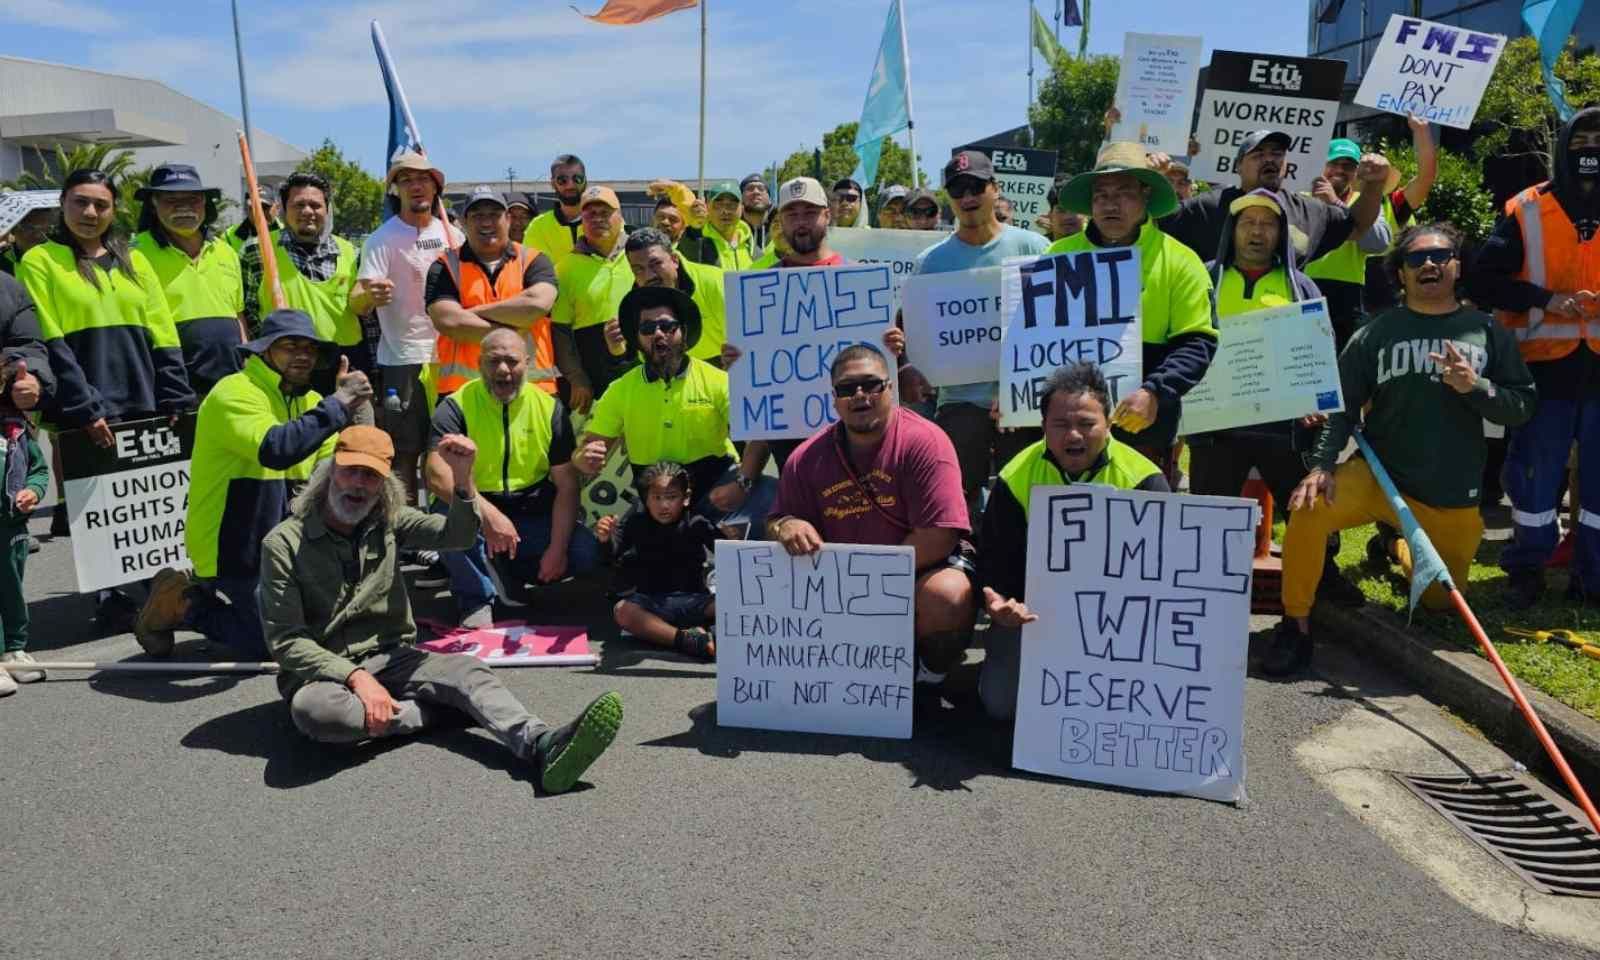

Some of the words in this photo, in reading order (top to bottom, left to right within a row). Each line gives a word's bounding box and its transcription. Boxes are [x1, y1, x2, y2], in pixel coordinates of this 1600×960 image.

[1400, 54, 1464, 83] DONT
[1399, 81, 1445, 106] PAY
[1213, 100, 1325, 127] WORKERS
[1214, 128, 1312, 154] DEVE
[999, 180, 1046, 195] RKERS
[740, 267, 890, 337] FMI
[1020, 250, 1135, 329] FMI
[936, 298, 989, 317] TOOT
[939, 326, 1002, 347] SUPPO
[750, 341, 880, 389] LOCK
[1013, 338, 1123, 373] LOCKED
[1011, 376, 1048, 413] ME
[743, 394, 788, 431] ME
[804, 394, 838, 428] OU
[86, 497, 175, 530] RIGHTS
[114, 519, 185, 549] HUMA
[1048, 493, 1252, 595] FMI
[121, 543, 185, 574] RIGH
[737, 546, 912, 616] FMI
[724, 612, 823, 639] LEADING
[1075, 591, 1206, 672] WE
[746, 643, 911, 673] MANUFACTURER
[733, 677, 776, 704] BUT
[794, 681, 832, 705] NOT
[843, 683, 911, 711] STAFF
[1040, 668, 1212, 722] DESERVE
[1060, 717, 1232, 777] BETTER
